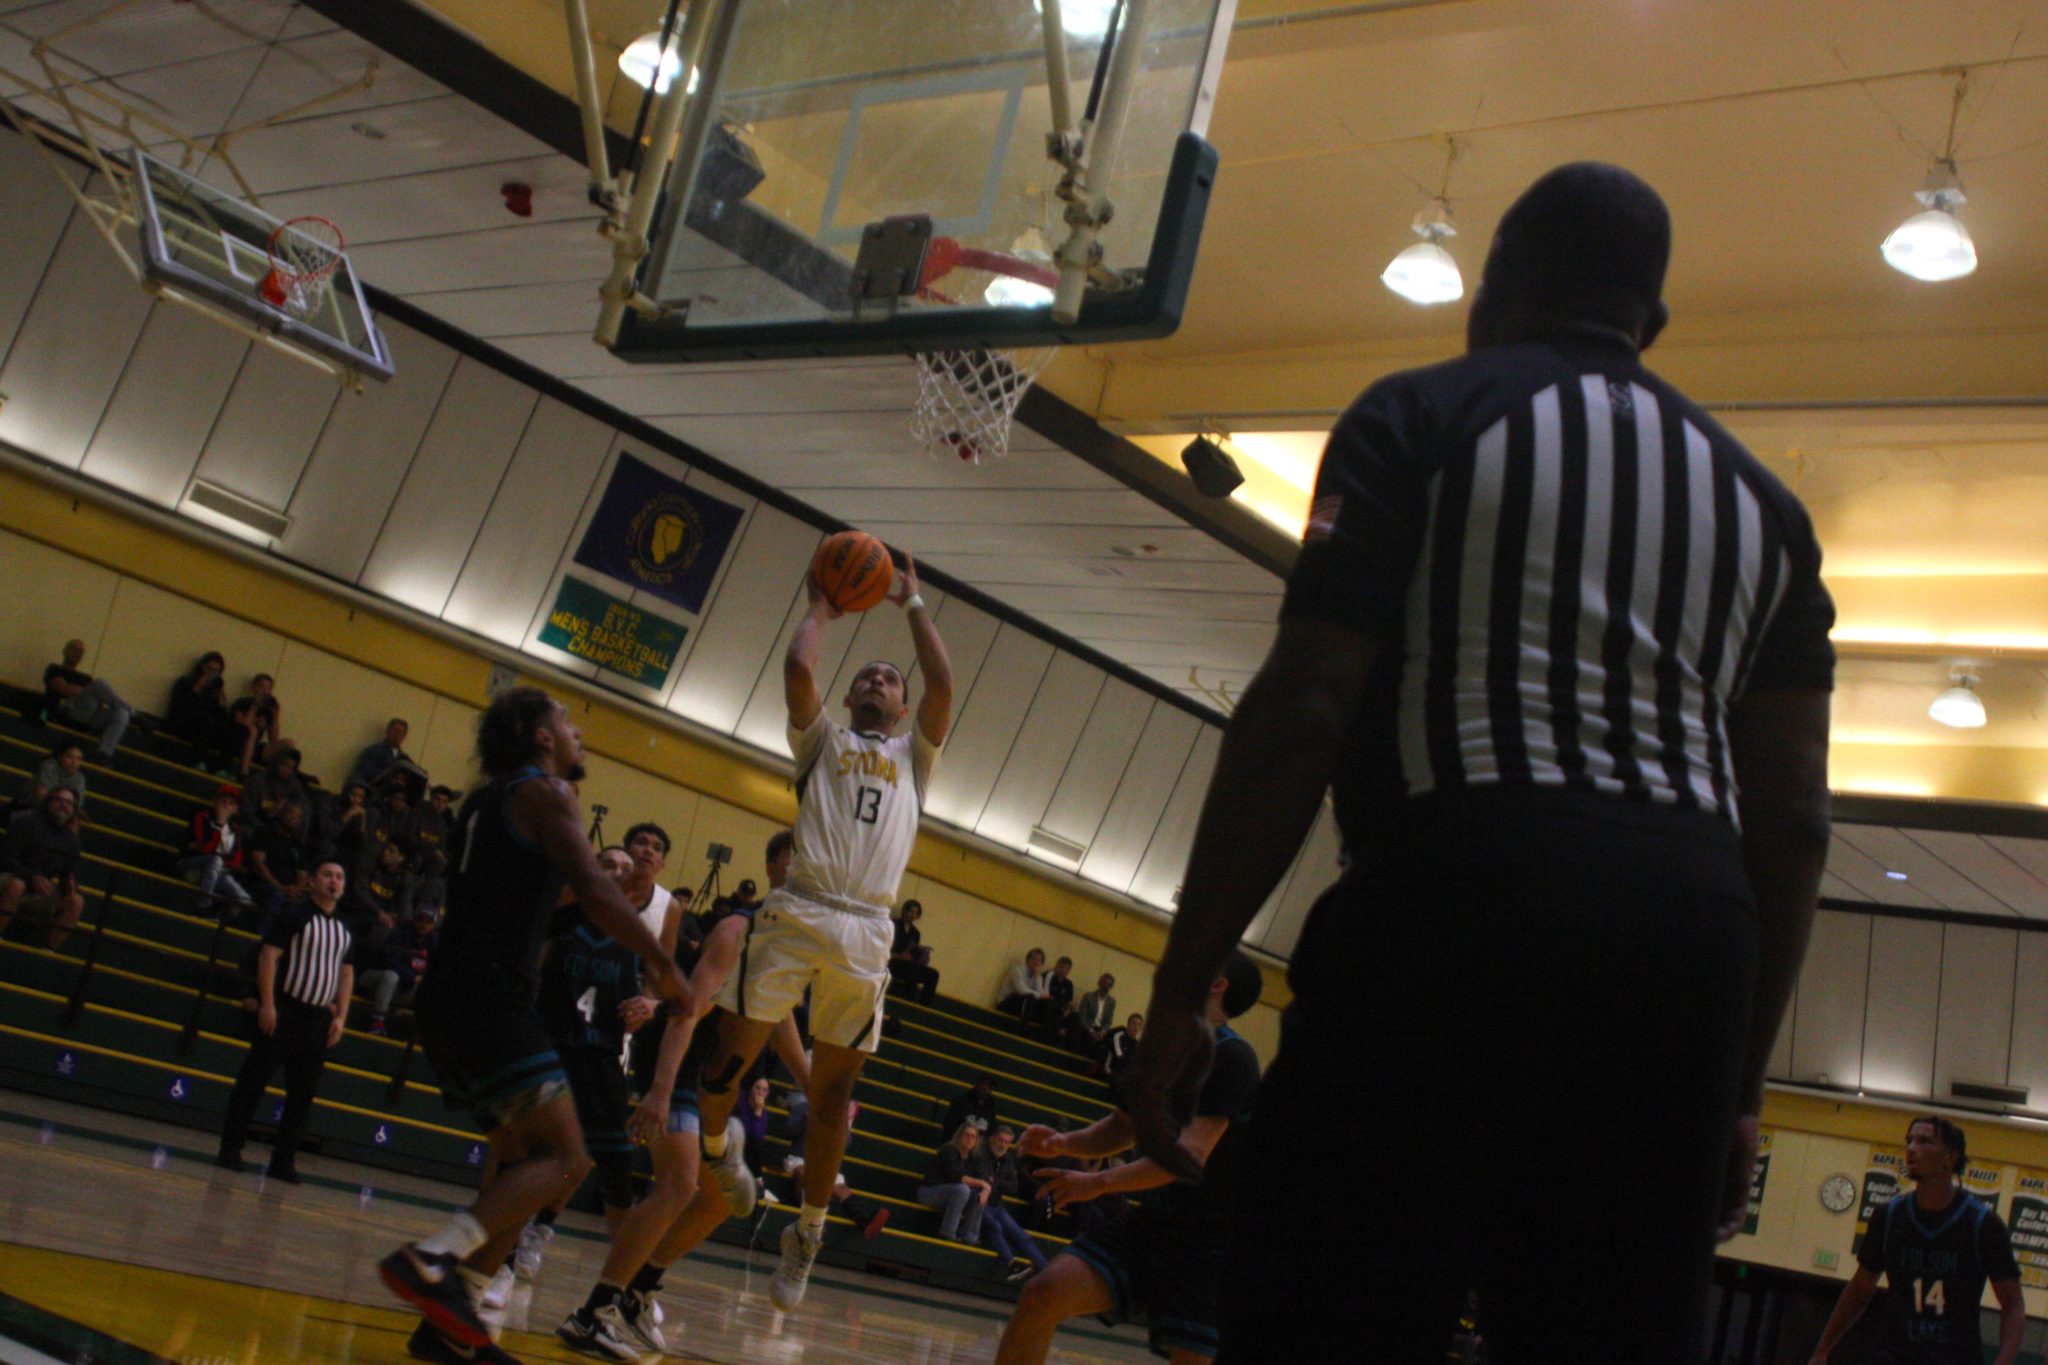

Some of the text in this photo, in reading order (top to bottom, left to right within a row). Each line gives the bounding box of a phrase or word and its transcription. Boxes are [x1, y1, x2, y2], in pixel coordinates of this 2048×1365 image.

[566, 634, 645, 677] CHAMPIONS
[590, 623, 671, 672] BASKETBALL
[854, 785, 883, 824] 13
[575, 985, 598, 1023] 4
[2020, 1178, 2045, 1190] NAPA
[1912, 1277, 1947, 1317] 14
